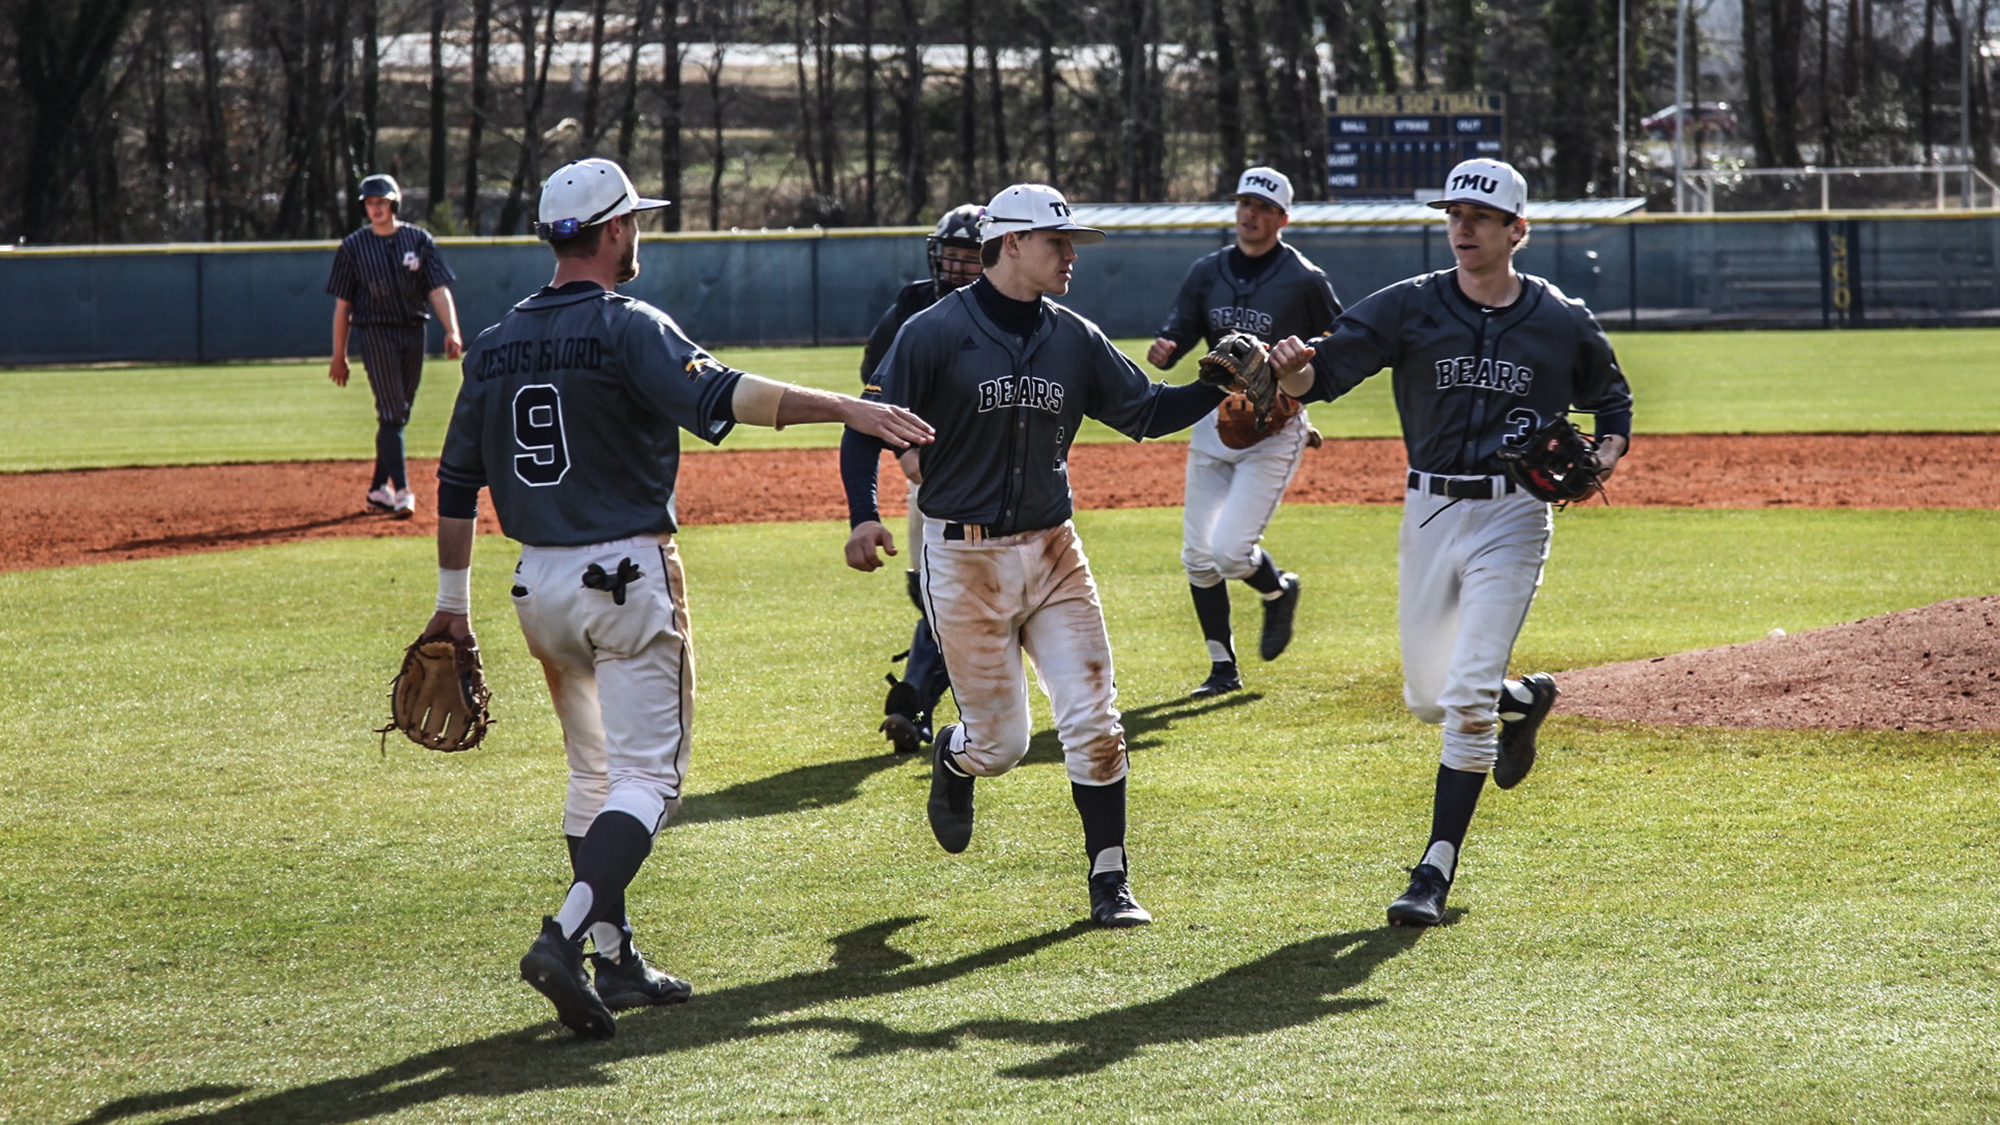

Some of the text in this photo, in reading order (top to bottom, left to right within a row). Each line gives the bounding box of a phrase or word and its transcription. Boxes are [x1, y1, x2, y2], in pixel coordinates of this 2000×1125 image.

[1337, 93, 1494, 114] BEARS SOFTBALL
[1456, 119, 1482, 131] OUT
[1245, 175, 1279, 193] TMU
[1451, 173, 1498, 194] TMU
[1209, 306, 1274, 335] BEARS
[476, 340, 532, 382] JESUS
[553, 337, 602, 371] LORD
[1435, 356, 1534, 397] BEARS
[978, 375, 1065, 414] BEARS
[512, 383, 571, 487] 9
[1502, 407, 1541, 448] 3
